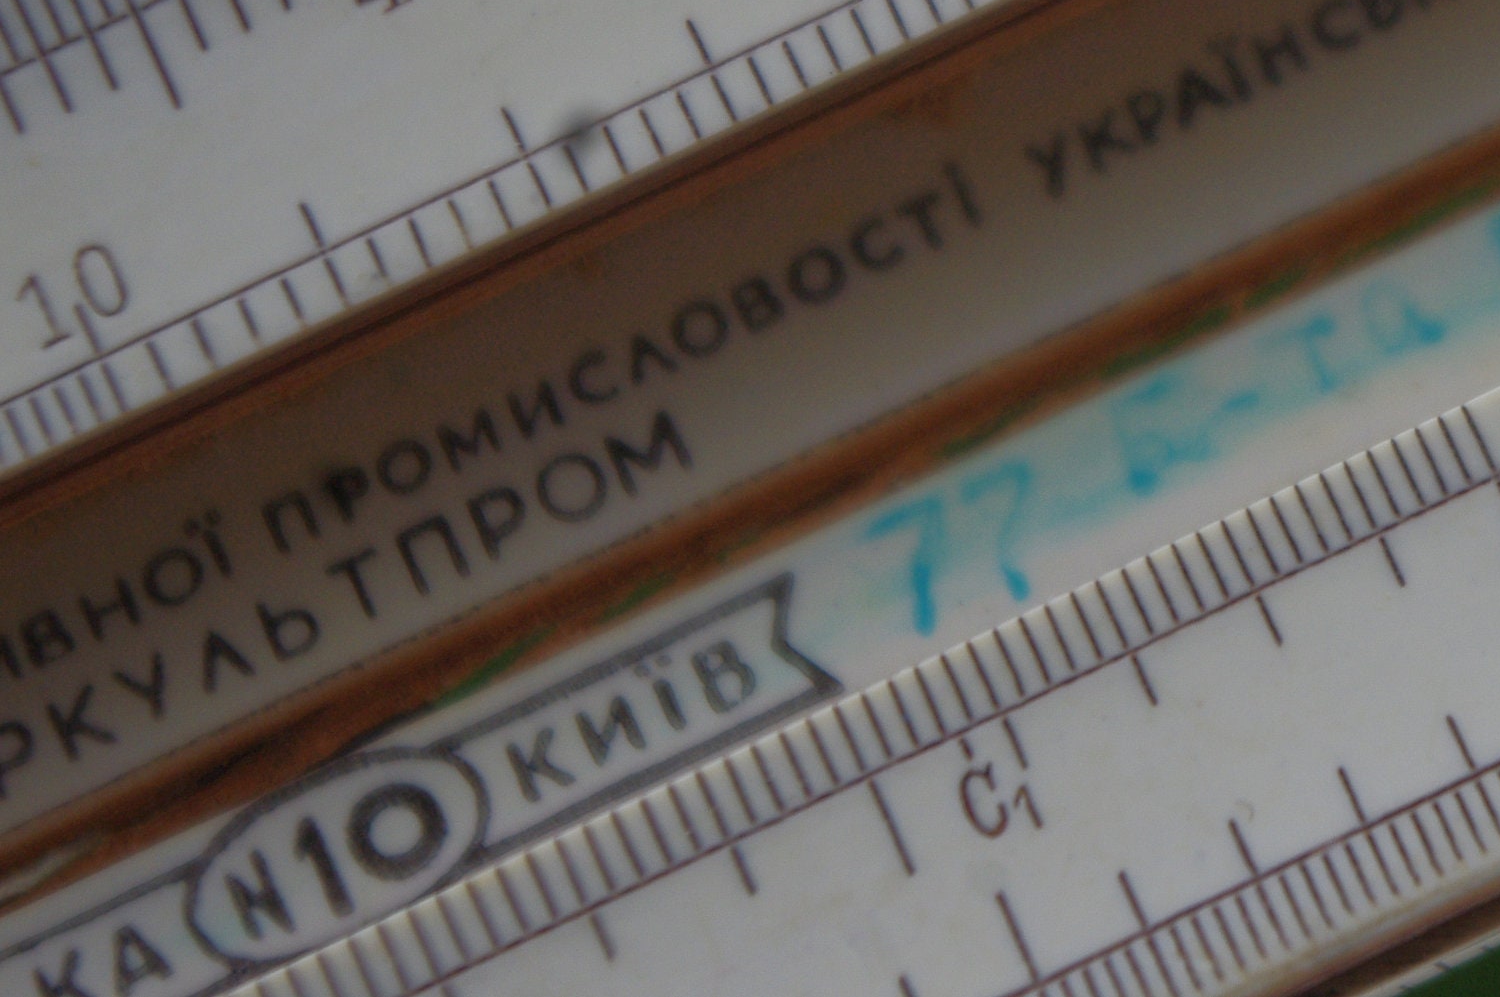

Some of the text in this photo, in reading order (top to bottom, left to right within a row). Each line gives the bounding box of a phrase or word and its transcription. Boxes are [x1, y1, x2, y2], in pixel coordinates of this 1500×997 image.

[15, 244, 129, 349] 10
[263, 162, 983, 554] ПРОМИСЛОВОСТІ
[506, 638, 757, 802] КИЇВ
